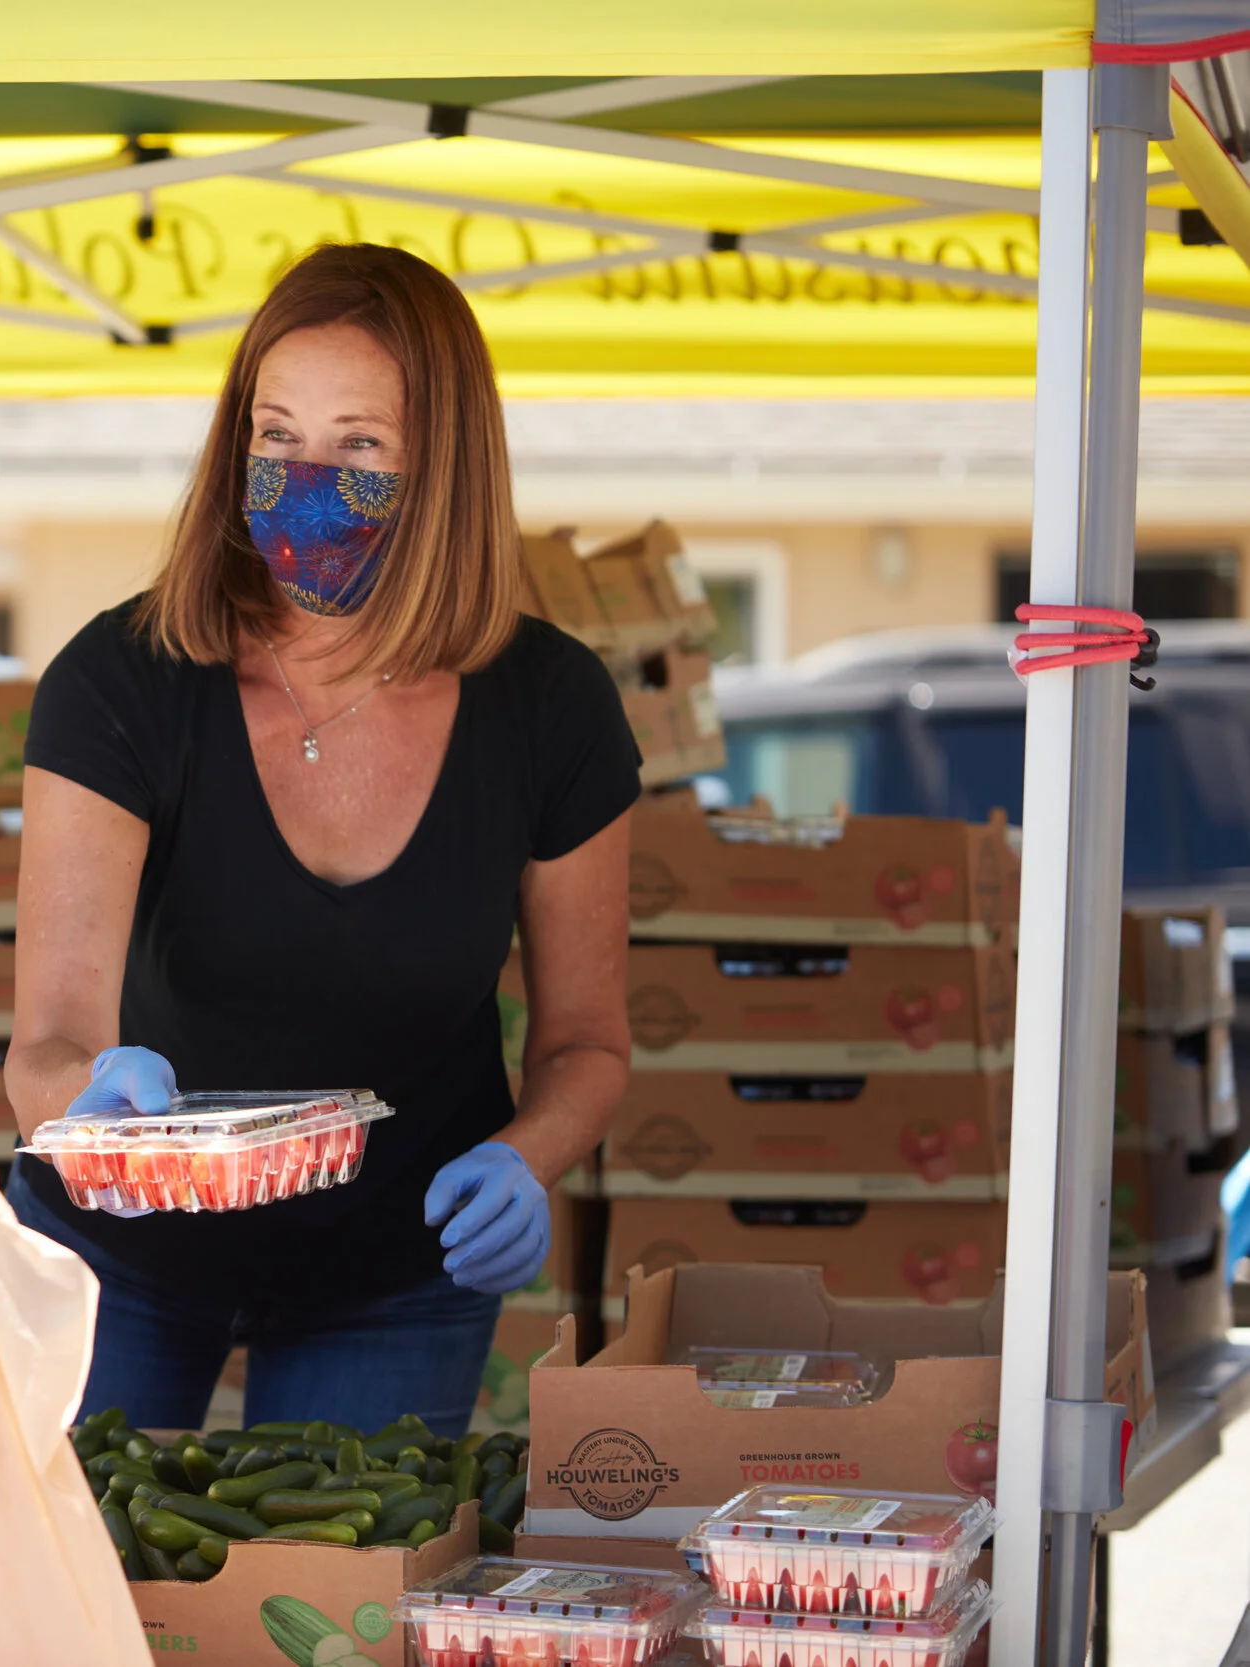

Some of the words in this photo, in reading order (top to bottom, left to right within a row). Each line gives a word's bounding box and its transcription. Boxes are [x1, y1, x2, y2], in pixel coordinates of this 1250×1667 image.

[577, 1439, 603, 1466] MASTERY
[603, 1436, 629, 1447] UNDER
[629, 1442, 648, 1465] GLASS
[739, 1453, 802, 1462] GREENHOUSE
[804, 1452, 841, 1460] GROWN
[546, 1467, 680, 1485] HOUWELING'S
[739, 1463, 861, 1482] TOMATOES
[582, 1487, 646, 1513] TOMATOES
